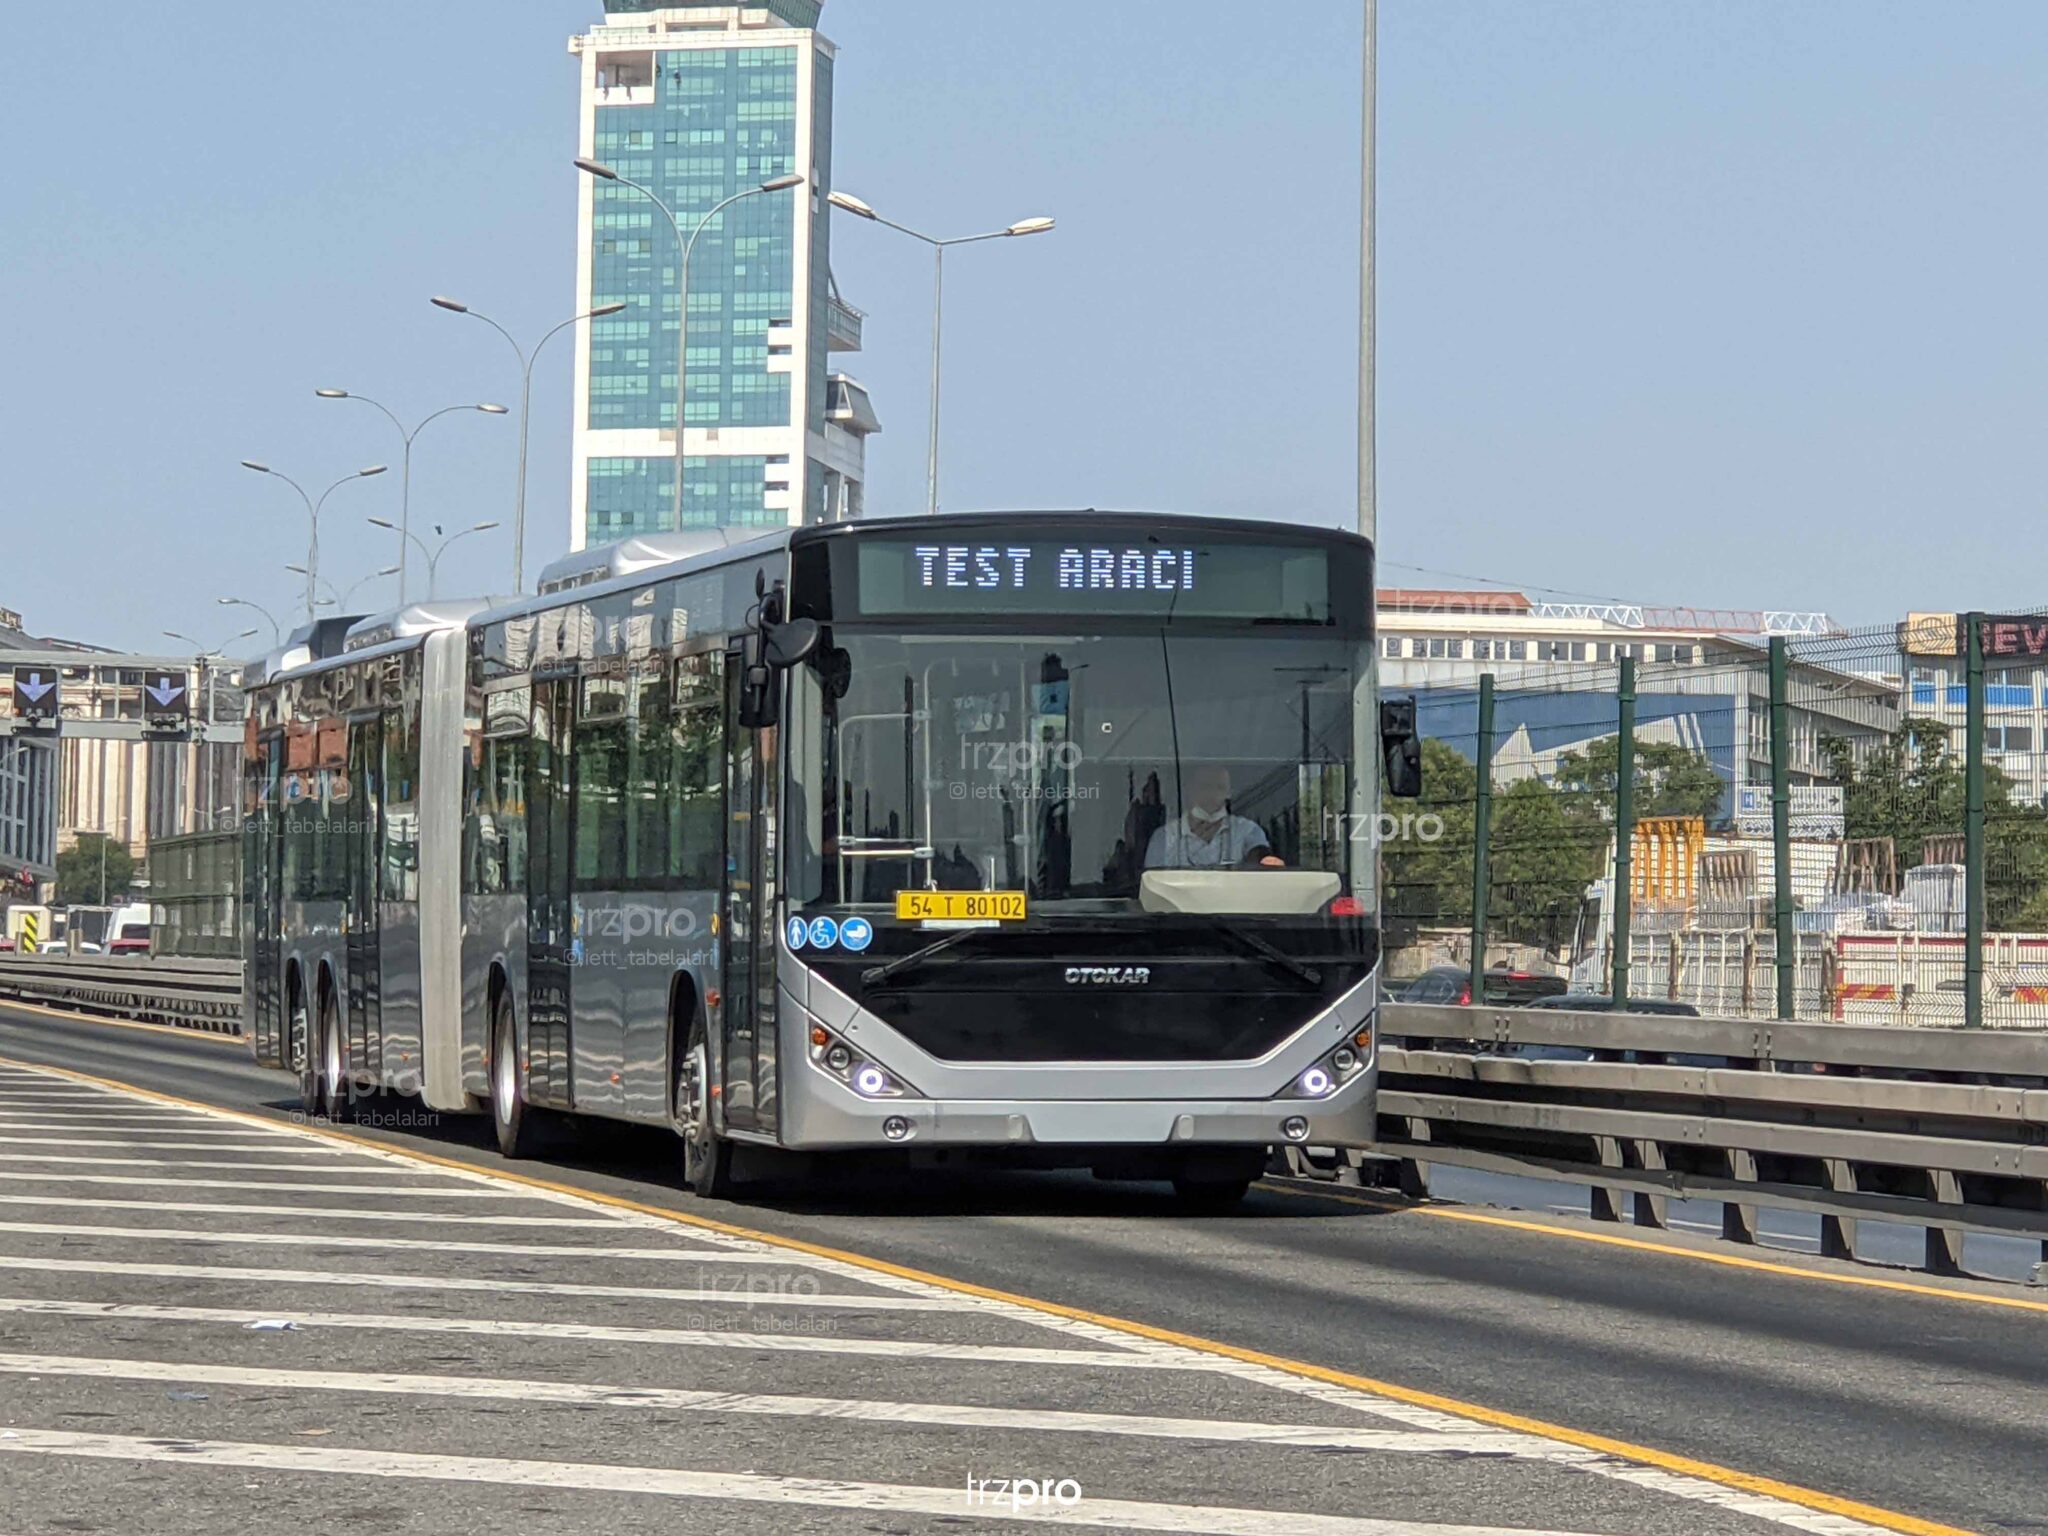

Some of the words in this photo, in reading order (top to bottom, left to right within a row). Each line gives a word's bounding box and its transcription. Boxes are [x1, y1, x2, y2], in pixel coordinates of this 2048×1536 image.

[915, 547, 1032, 587] TEST
[1059, 548, 1193, 589] ARACI
[911, 896, 932, 916] 54
[944, 897, 953, 916] T
[966, 897, 1022, 916] 80102
[1064, 967, 1150, 984] OTOKAR
